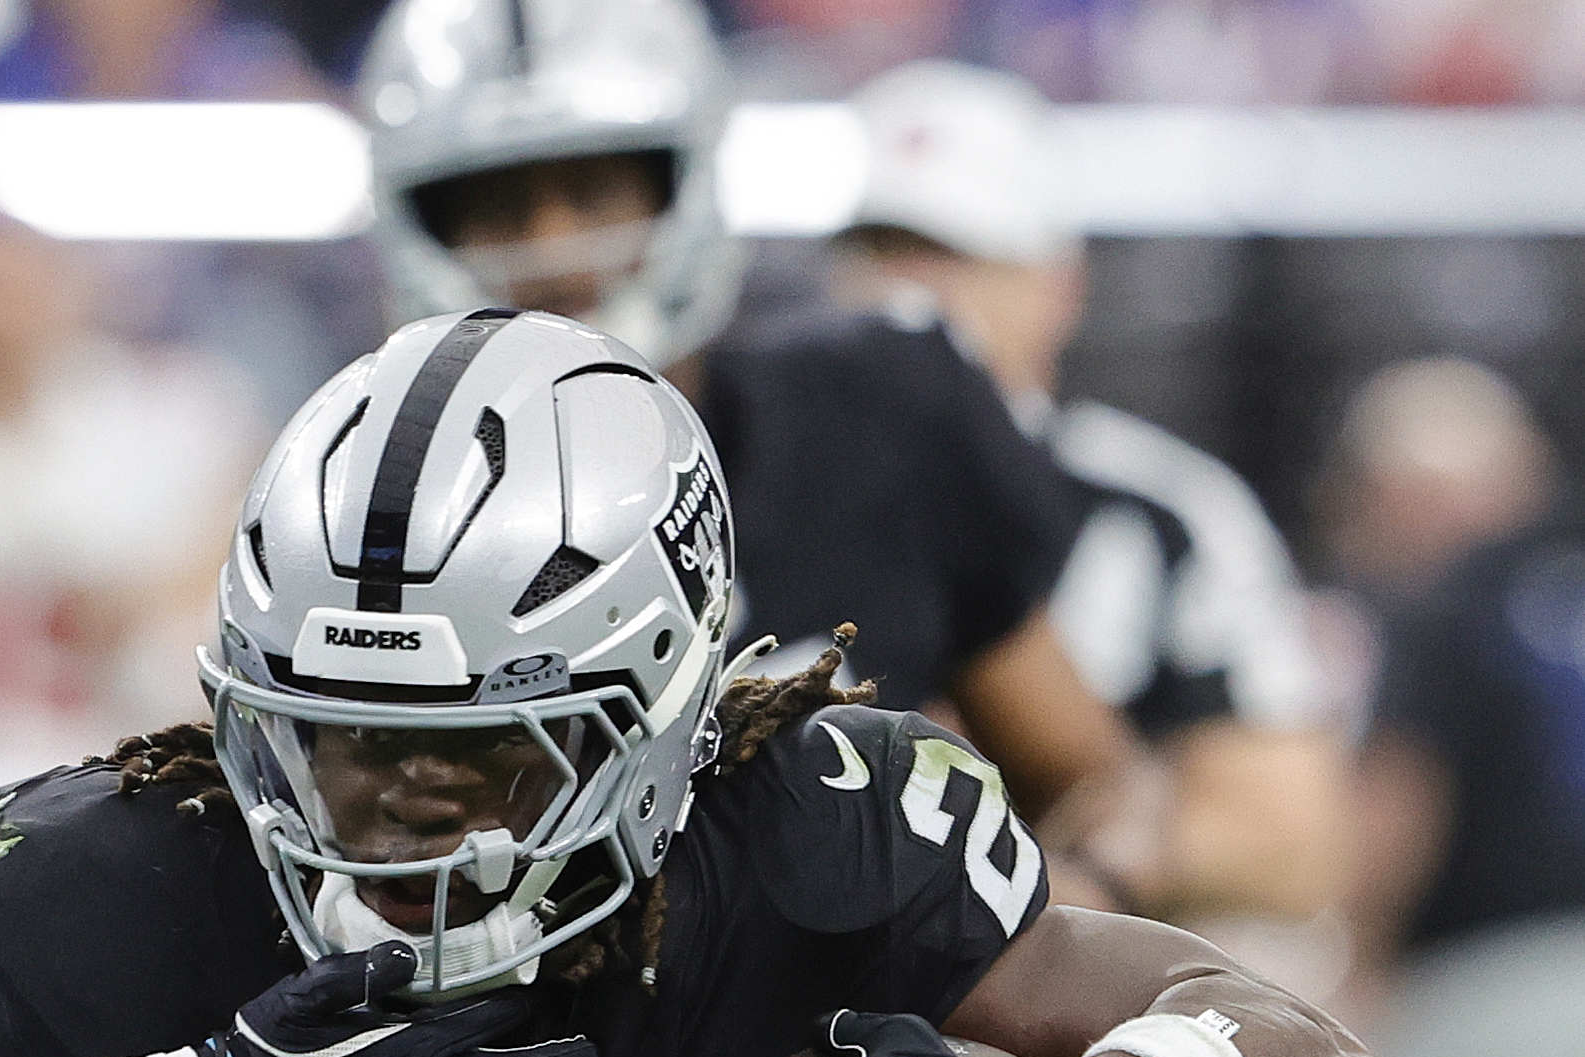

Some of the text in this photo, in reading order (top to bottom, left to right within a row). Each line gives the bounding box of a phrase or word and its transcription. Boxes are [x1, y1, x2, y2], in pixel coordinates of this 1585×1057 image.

[661, 461, 711, 542] RAIDERS
[325, 625, 422, 651] RAIDERS
[490, 666, 565, 693] OAKLEY
[900, 739, 1042, 939] 2
